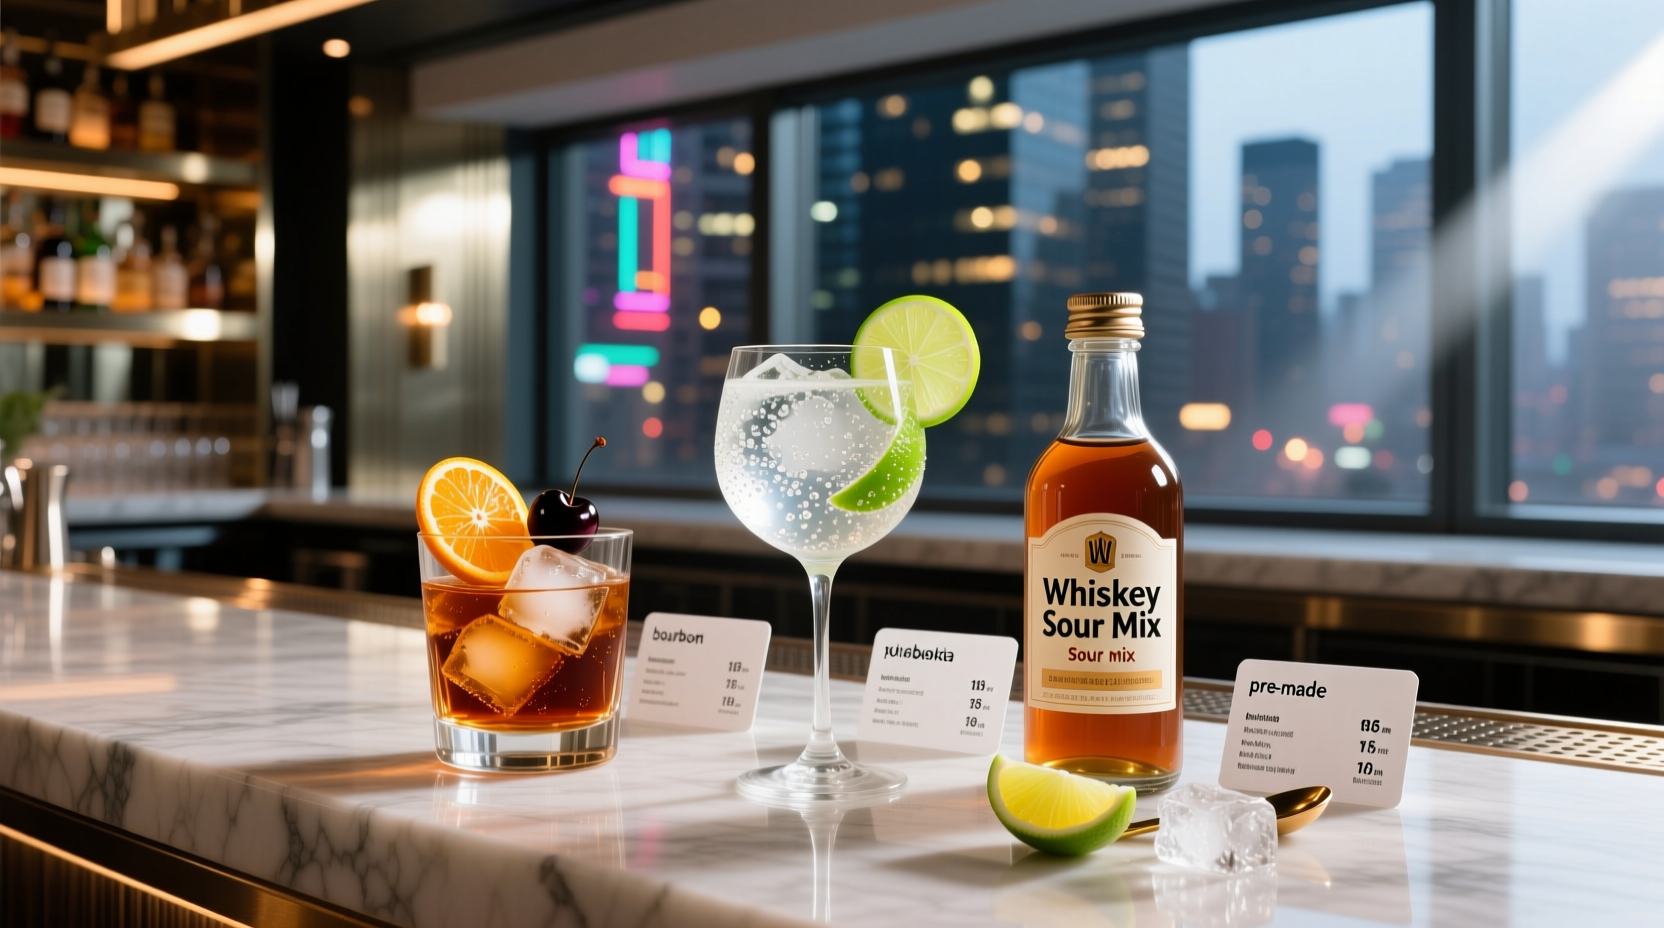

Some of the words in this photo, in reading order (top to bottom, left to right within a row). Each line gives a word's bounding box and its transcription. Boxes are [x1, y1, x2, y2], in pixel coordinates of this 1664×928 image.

[1088, 537, 1112, 564] W
[1043, 577, 1161, 614] Whiskey
[1043, 609, 1105, 638] Sour
[1112, 611, 1161, 639] Mix
[1068, 647, 1104, 662] Sour
[1109, 647, 1136, 662] mix
[1249, 680, 1327, 698] pre-made
